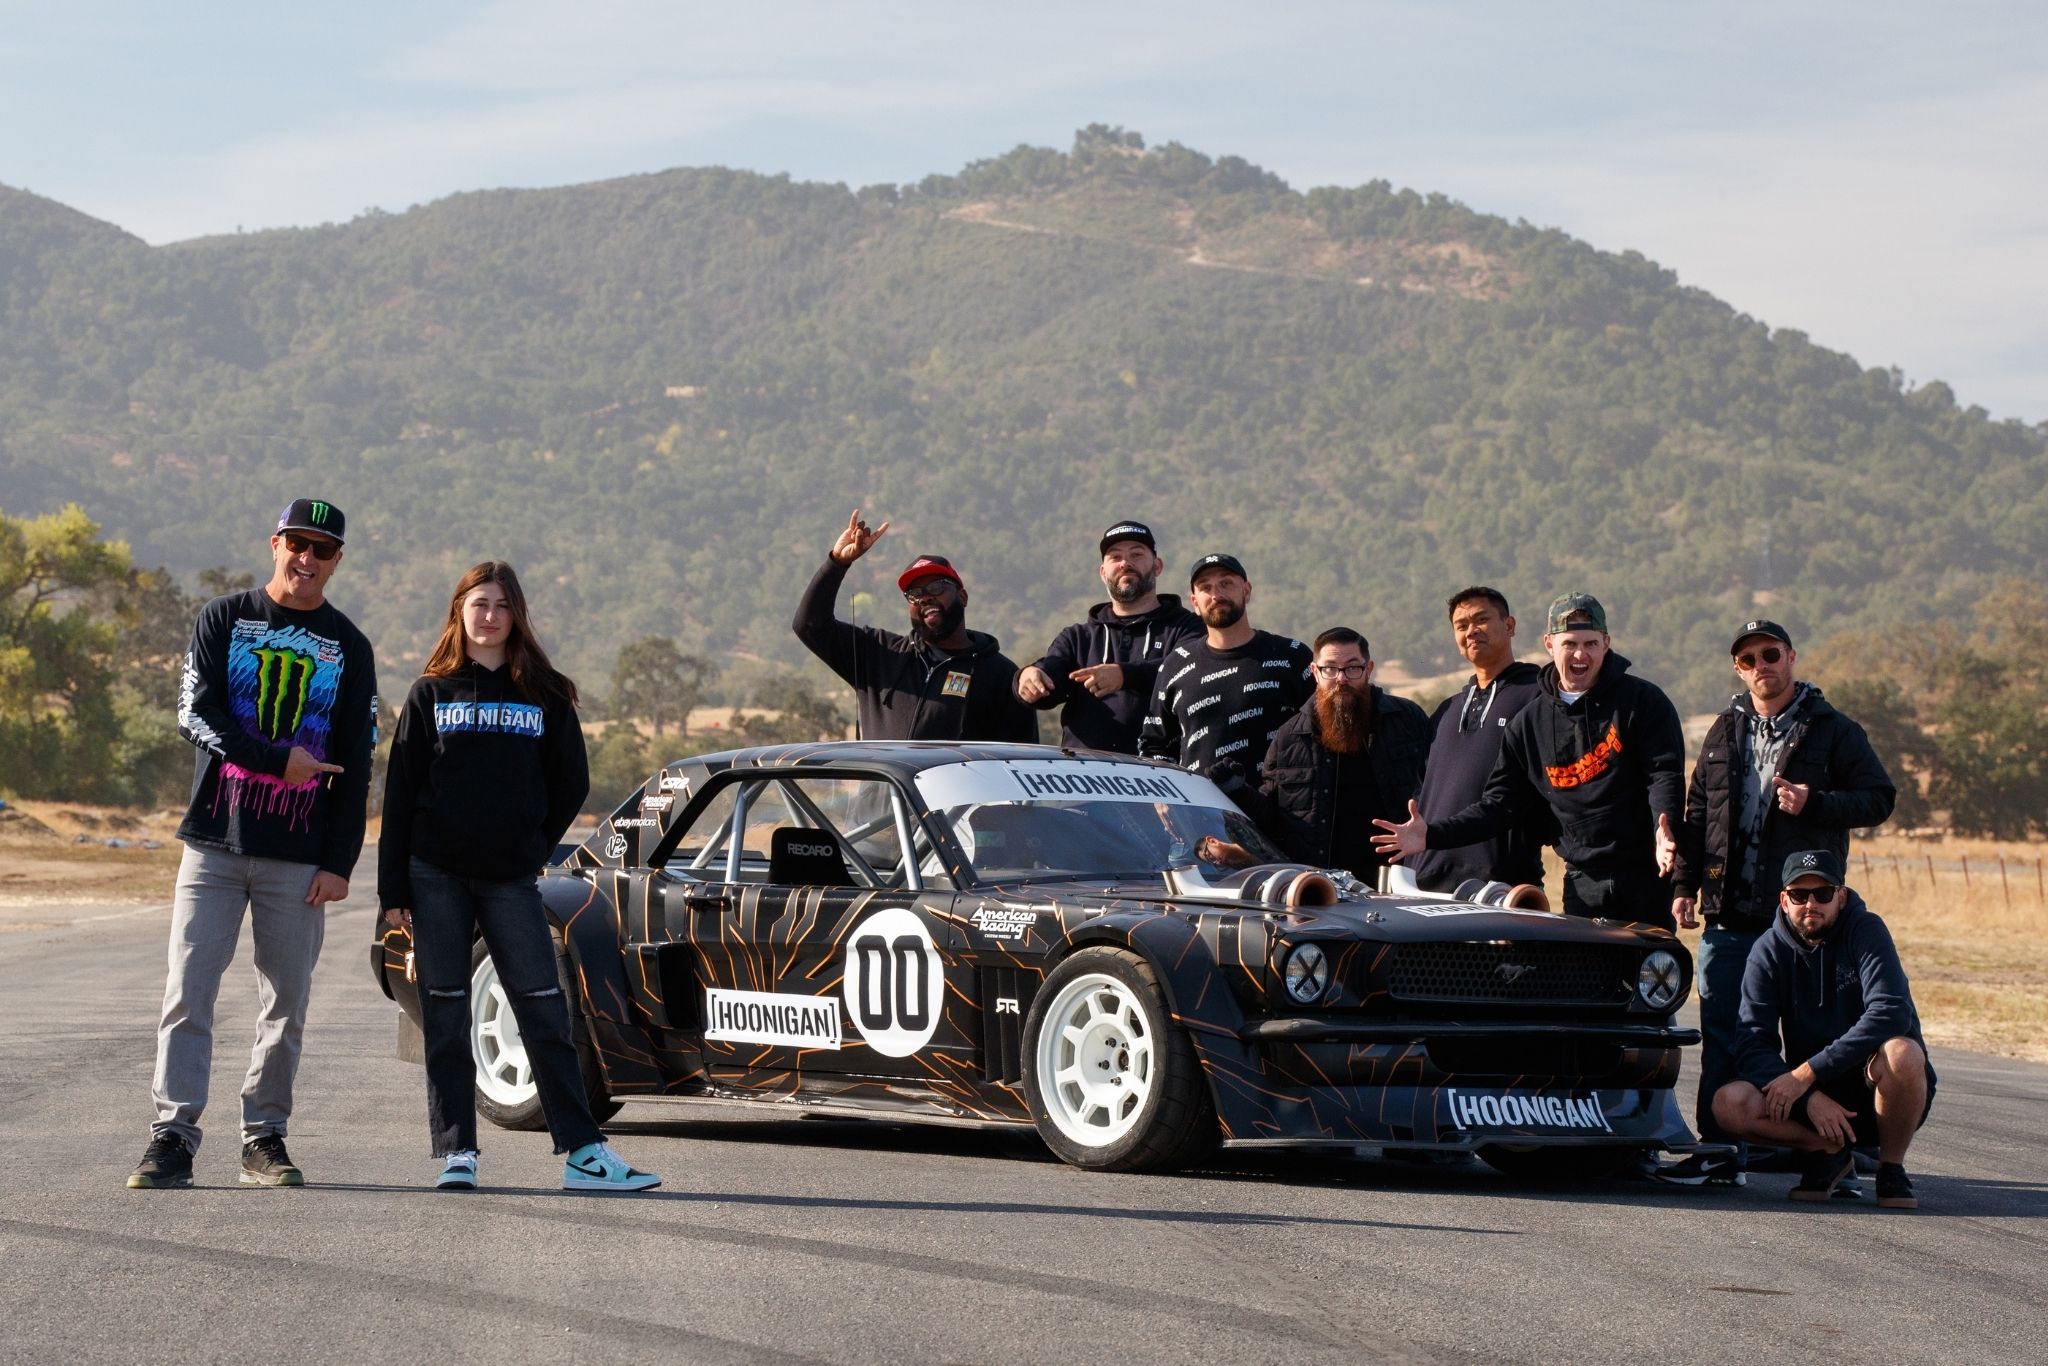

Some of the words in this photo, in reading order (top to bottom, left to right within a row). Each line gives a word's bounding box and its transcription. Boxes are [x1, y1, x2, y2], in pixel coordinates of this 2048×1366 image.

[1201, 667, 1238, 684] HOONIGAN
[1243, 681, 1280, 693] HOONIGAN
[1187, 695, 1221, 716] HOONIGAN
[1228, 707, 1263, 725] HOONIGAN
[1215, 739, 1249, 757] HOONIGAN
[787, 843, 834, 857] RECARO
[970, 906, 1037, 922] American
[979, 918, 1027, 940] Racing
[855, 934, 929, 1032] 00
